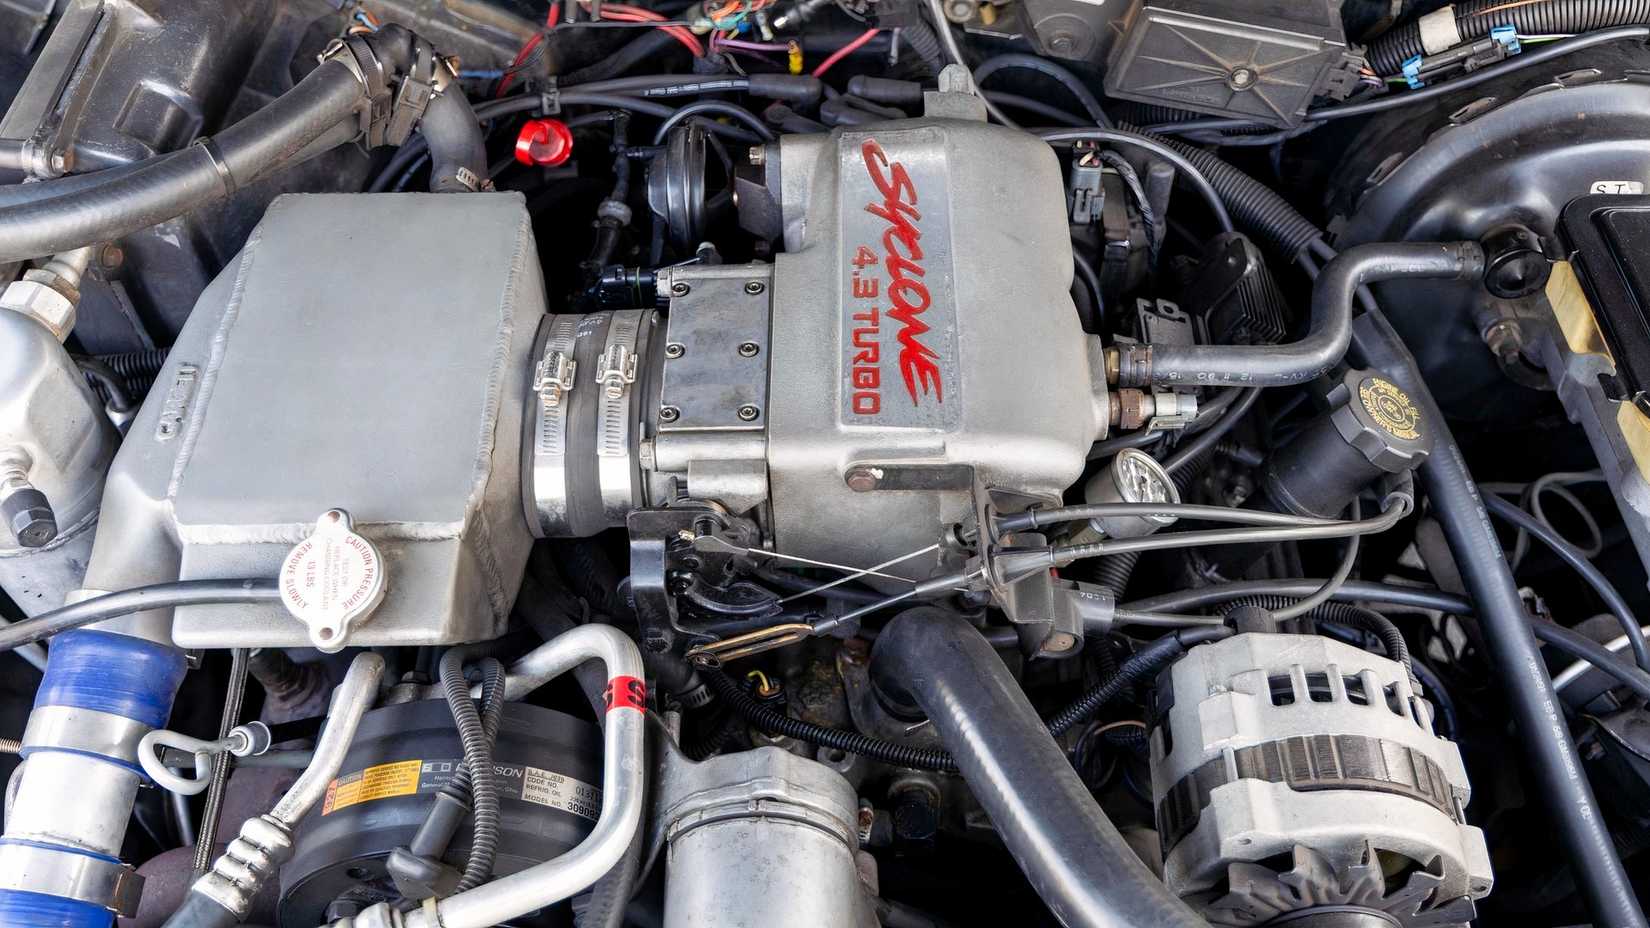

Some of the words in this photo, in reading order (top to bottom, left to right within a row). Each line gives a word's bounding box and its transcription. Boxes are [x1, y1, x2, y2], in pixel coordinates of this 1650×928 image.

[851, 246, 879, 299] 4.3
[852, 306, 881, 416] TURBO
[287, 541, 312, 575] REMOVE
[344, 535, 374, 566] CAUTION
[285, 577, 310, 611] SLOWLY
[342, 566, 375, 610] PRESSURE
[524, 793, 549, 804] MODEL
